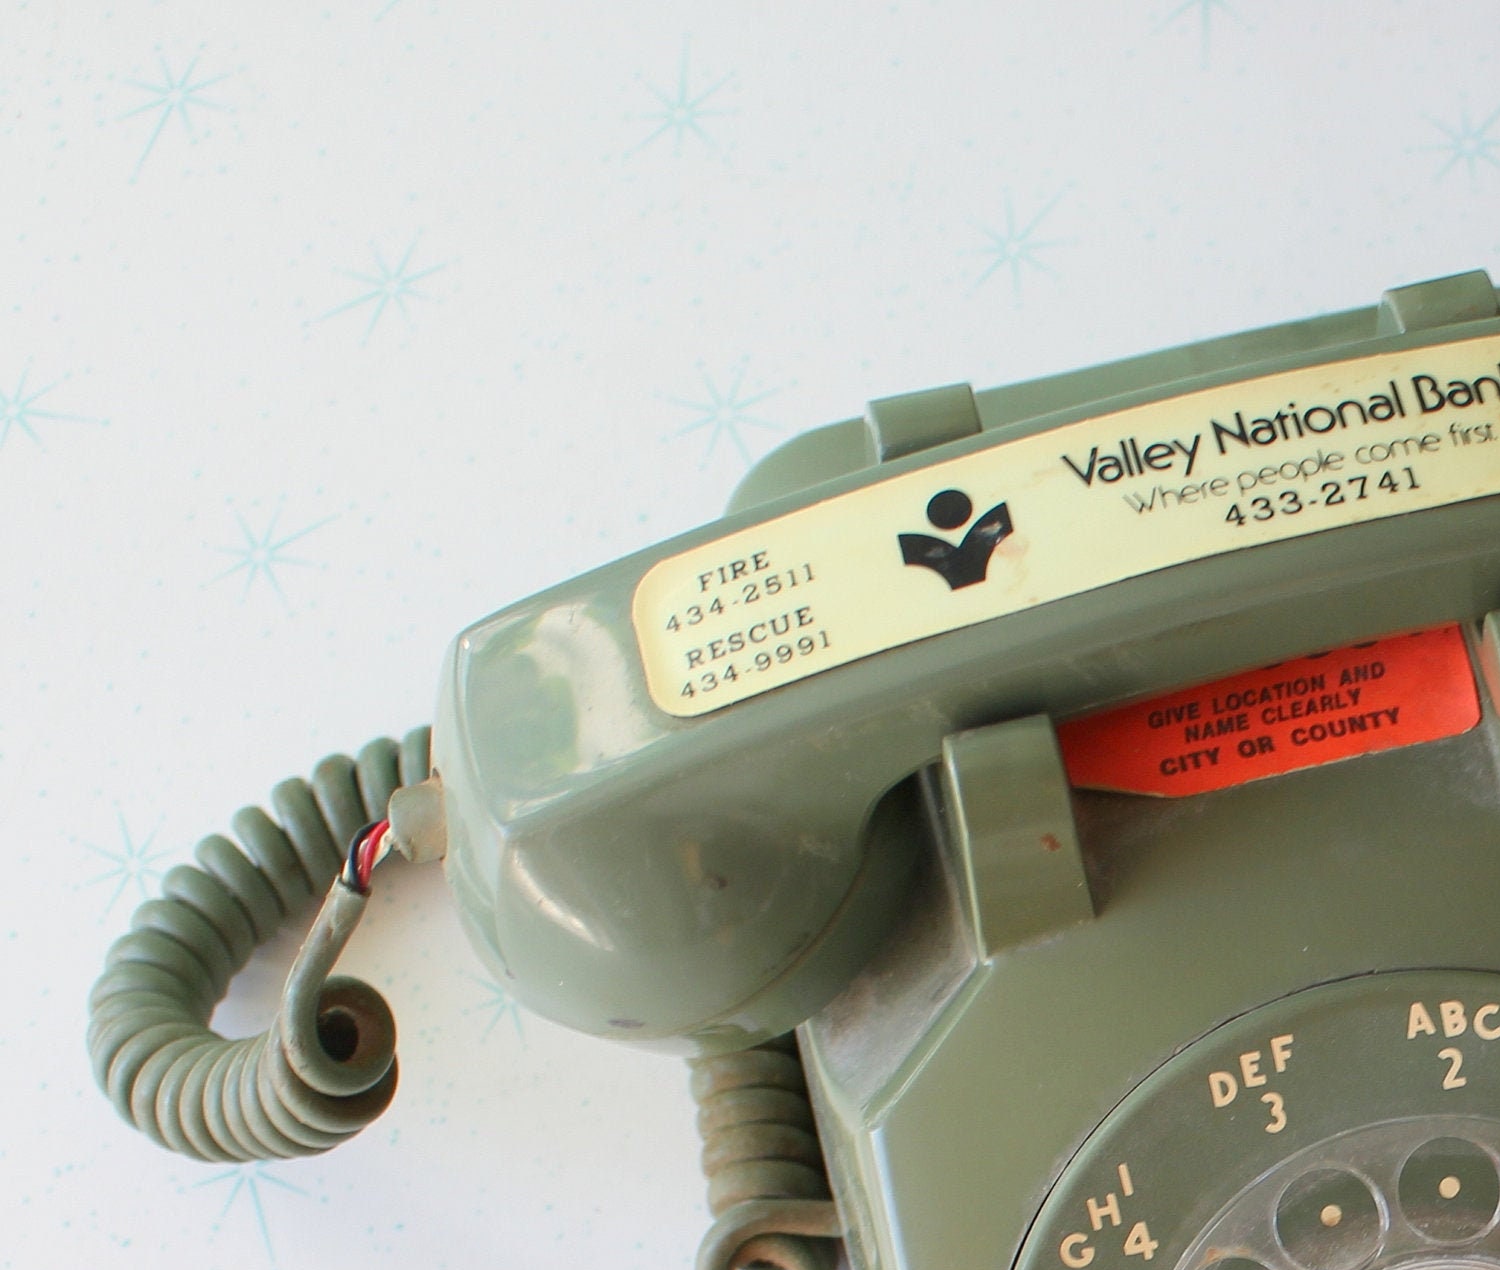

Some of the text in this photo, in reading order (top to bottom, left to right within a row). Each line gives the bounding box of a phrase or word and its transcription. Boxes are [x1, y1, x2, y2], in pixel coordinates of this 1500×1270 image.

[1061, 433, 1202, 487] Valley
[1211, 381, 1406, 456] National
[1122, 475, 1230, 515] Where
[1237, 448, 1345, 490] people
[1355, 429, 1441, 465] come
[1224, 466, 1420, 528] 433-2741
[665, 562, 816, 634] 434-2511
[698, 550, 771, 593] FIRE
[680, 630, 832, 700] 434-9991
[685, 606, 816, 669] RESCUE
[1148, 661, 1385, 729] GIVE LOCATION AND
[1185, 688, 1362, 743] NAME CLEARLY
[1160, 708, 1400, 776] CITY OR COUNTY
[1207, 1033, 1295, 1108] DEF
[1437, 1046, 1468, 1090] 2
[1260, 1092, 1287, 1134] 3
[1124, 1220, 1159, 1261] 4
